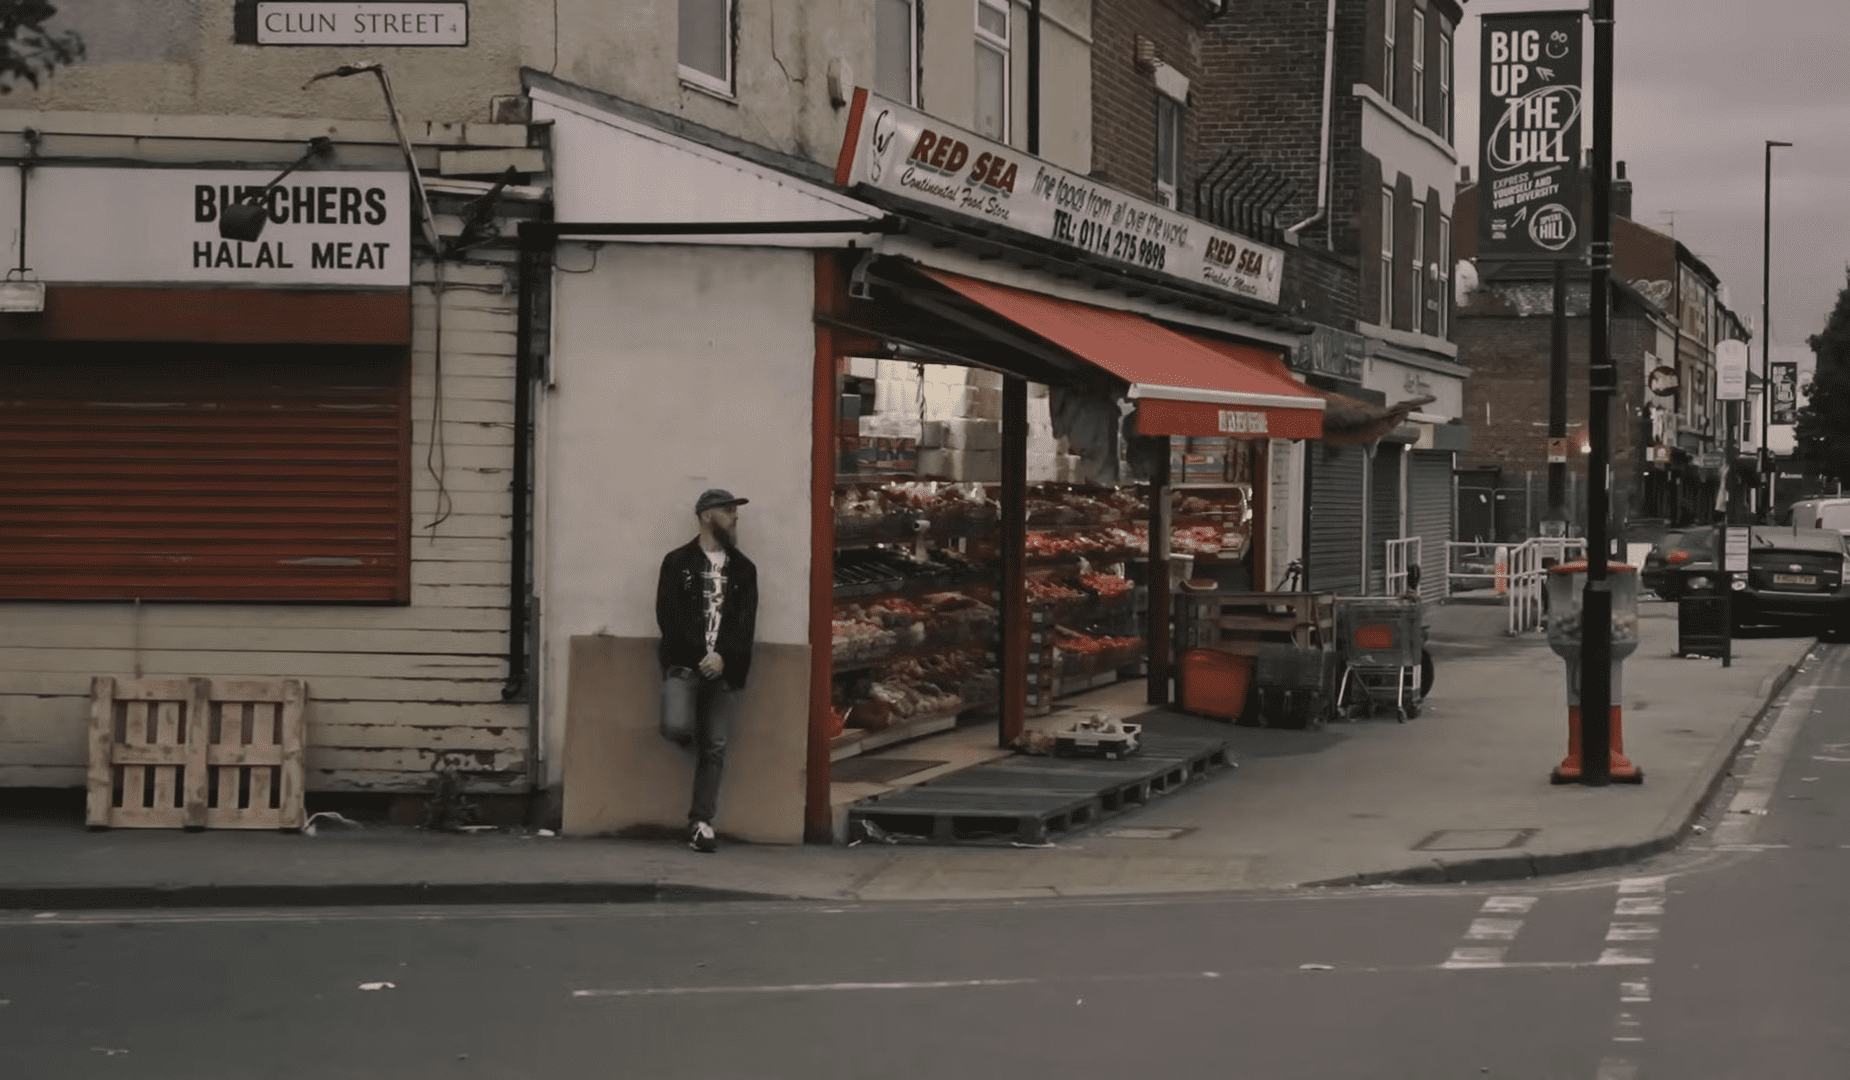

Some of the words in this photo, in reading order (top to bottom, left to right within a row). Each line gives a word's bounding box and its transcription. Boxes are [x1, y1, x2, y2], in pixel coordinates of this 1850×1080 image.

[265, 12, 336, 33] CLUN
[354, 13, 444, 34] STREET
[1491, 29, 1540, 63] BIG
[1491, 64, 1529, 97] UP
[1505, 96, 1560, 129] THE
[910, 128, 970, 174] RED
[970, 152, 1019, 195] SEA
[1509, 130, 1570, 163] HILL
[900, 167, 961, 201] Continental
[959, 187, 985, 209] Food
[985, 197, 1010, 220] Store
[1493, 171, 1530, 190] EXPRESS
[1493, 179, 1534, 200] YOURSELF
[1534, 175, 1553, 189] AND
[1493, 195, 1516, 210] YOUR
[1516, 183, 1560, 204] DIVERSITY
[1031, 166, 1056, 200] fine
[1054, 176, 1087, 212] foods
[1085, 188, 1113, 220] from
[1125, 207, 1148, 233] over
[1145, 212, 1162, 238] the
[1052, 208, 1077, 243] TEL:
[1079, 218, 1111, 254] 0114
[1113, 230, 1138, 261] 275
[1139, 237, 1167, 270] 9898
[1540, 220, 1565, 239] HILL
[193, 241, 294, 268] HALAL
[311, 242, 390, 269] MEAT
[1205, 236, 1236, 265] RED
[1237, 247, 1263, 276] SEA
